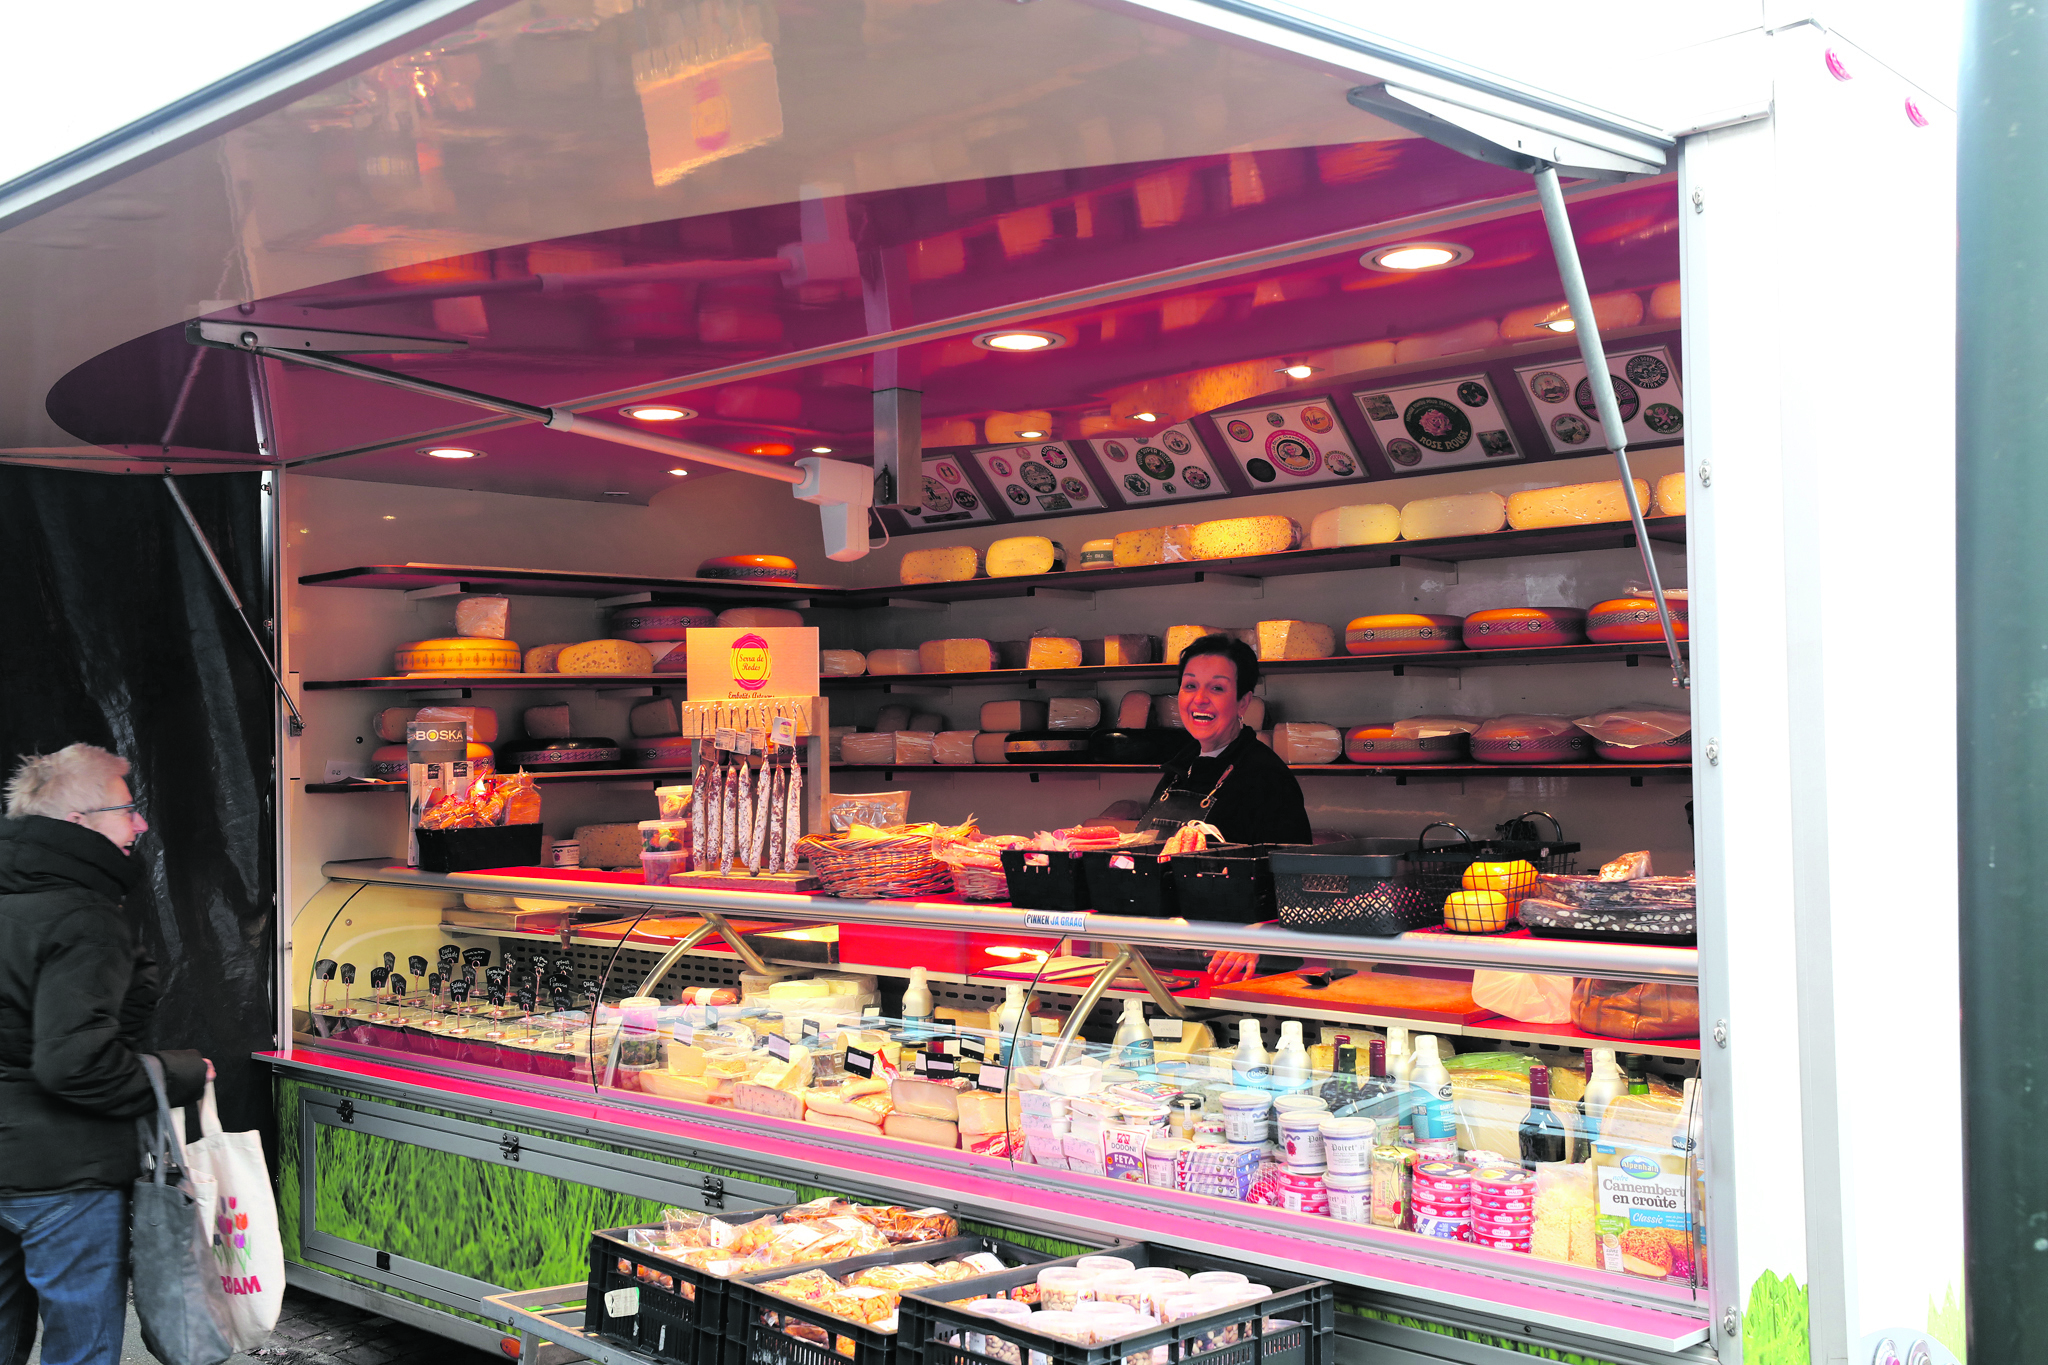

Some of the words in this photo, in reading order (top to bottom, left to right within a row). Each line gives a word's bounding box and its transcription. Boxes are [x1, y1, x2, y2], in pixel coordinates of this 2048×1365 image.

[1419, 436, 1443, 450] ROSE
[1445, 429, 1469, 450] ROUGE
[738, 654, 756, 662] Serra
[742, 663, 761, 671] Rodes
[416, 730, 463, 742] BOSKA
[1026, 914, 1050, 925] PINNEN
[1050, 916, 1060, 926] JA
[1060, 917, 1083, 927] GRAAG
[1111, 1142, 1137, 1152] DODONI
[1331, 1143, 1355, 1151] Poiret
[1114, 1154, 1135, 1165] FETA
[1621, 1161, 1659, 1173] Alpenhain
[1602, 1178, 1685, 1198] Camembert
[1612, 1194, 1629, 1204] en
[1632, 1196, 1677, 1209] croûte
[1632, 1212, 1663, 1224] Classic
